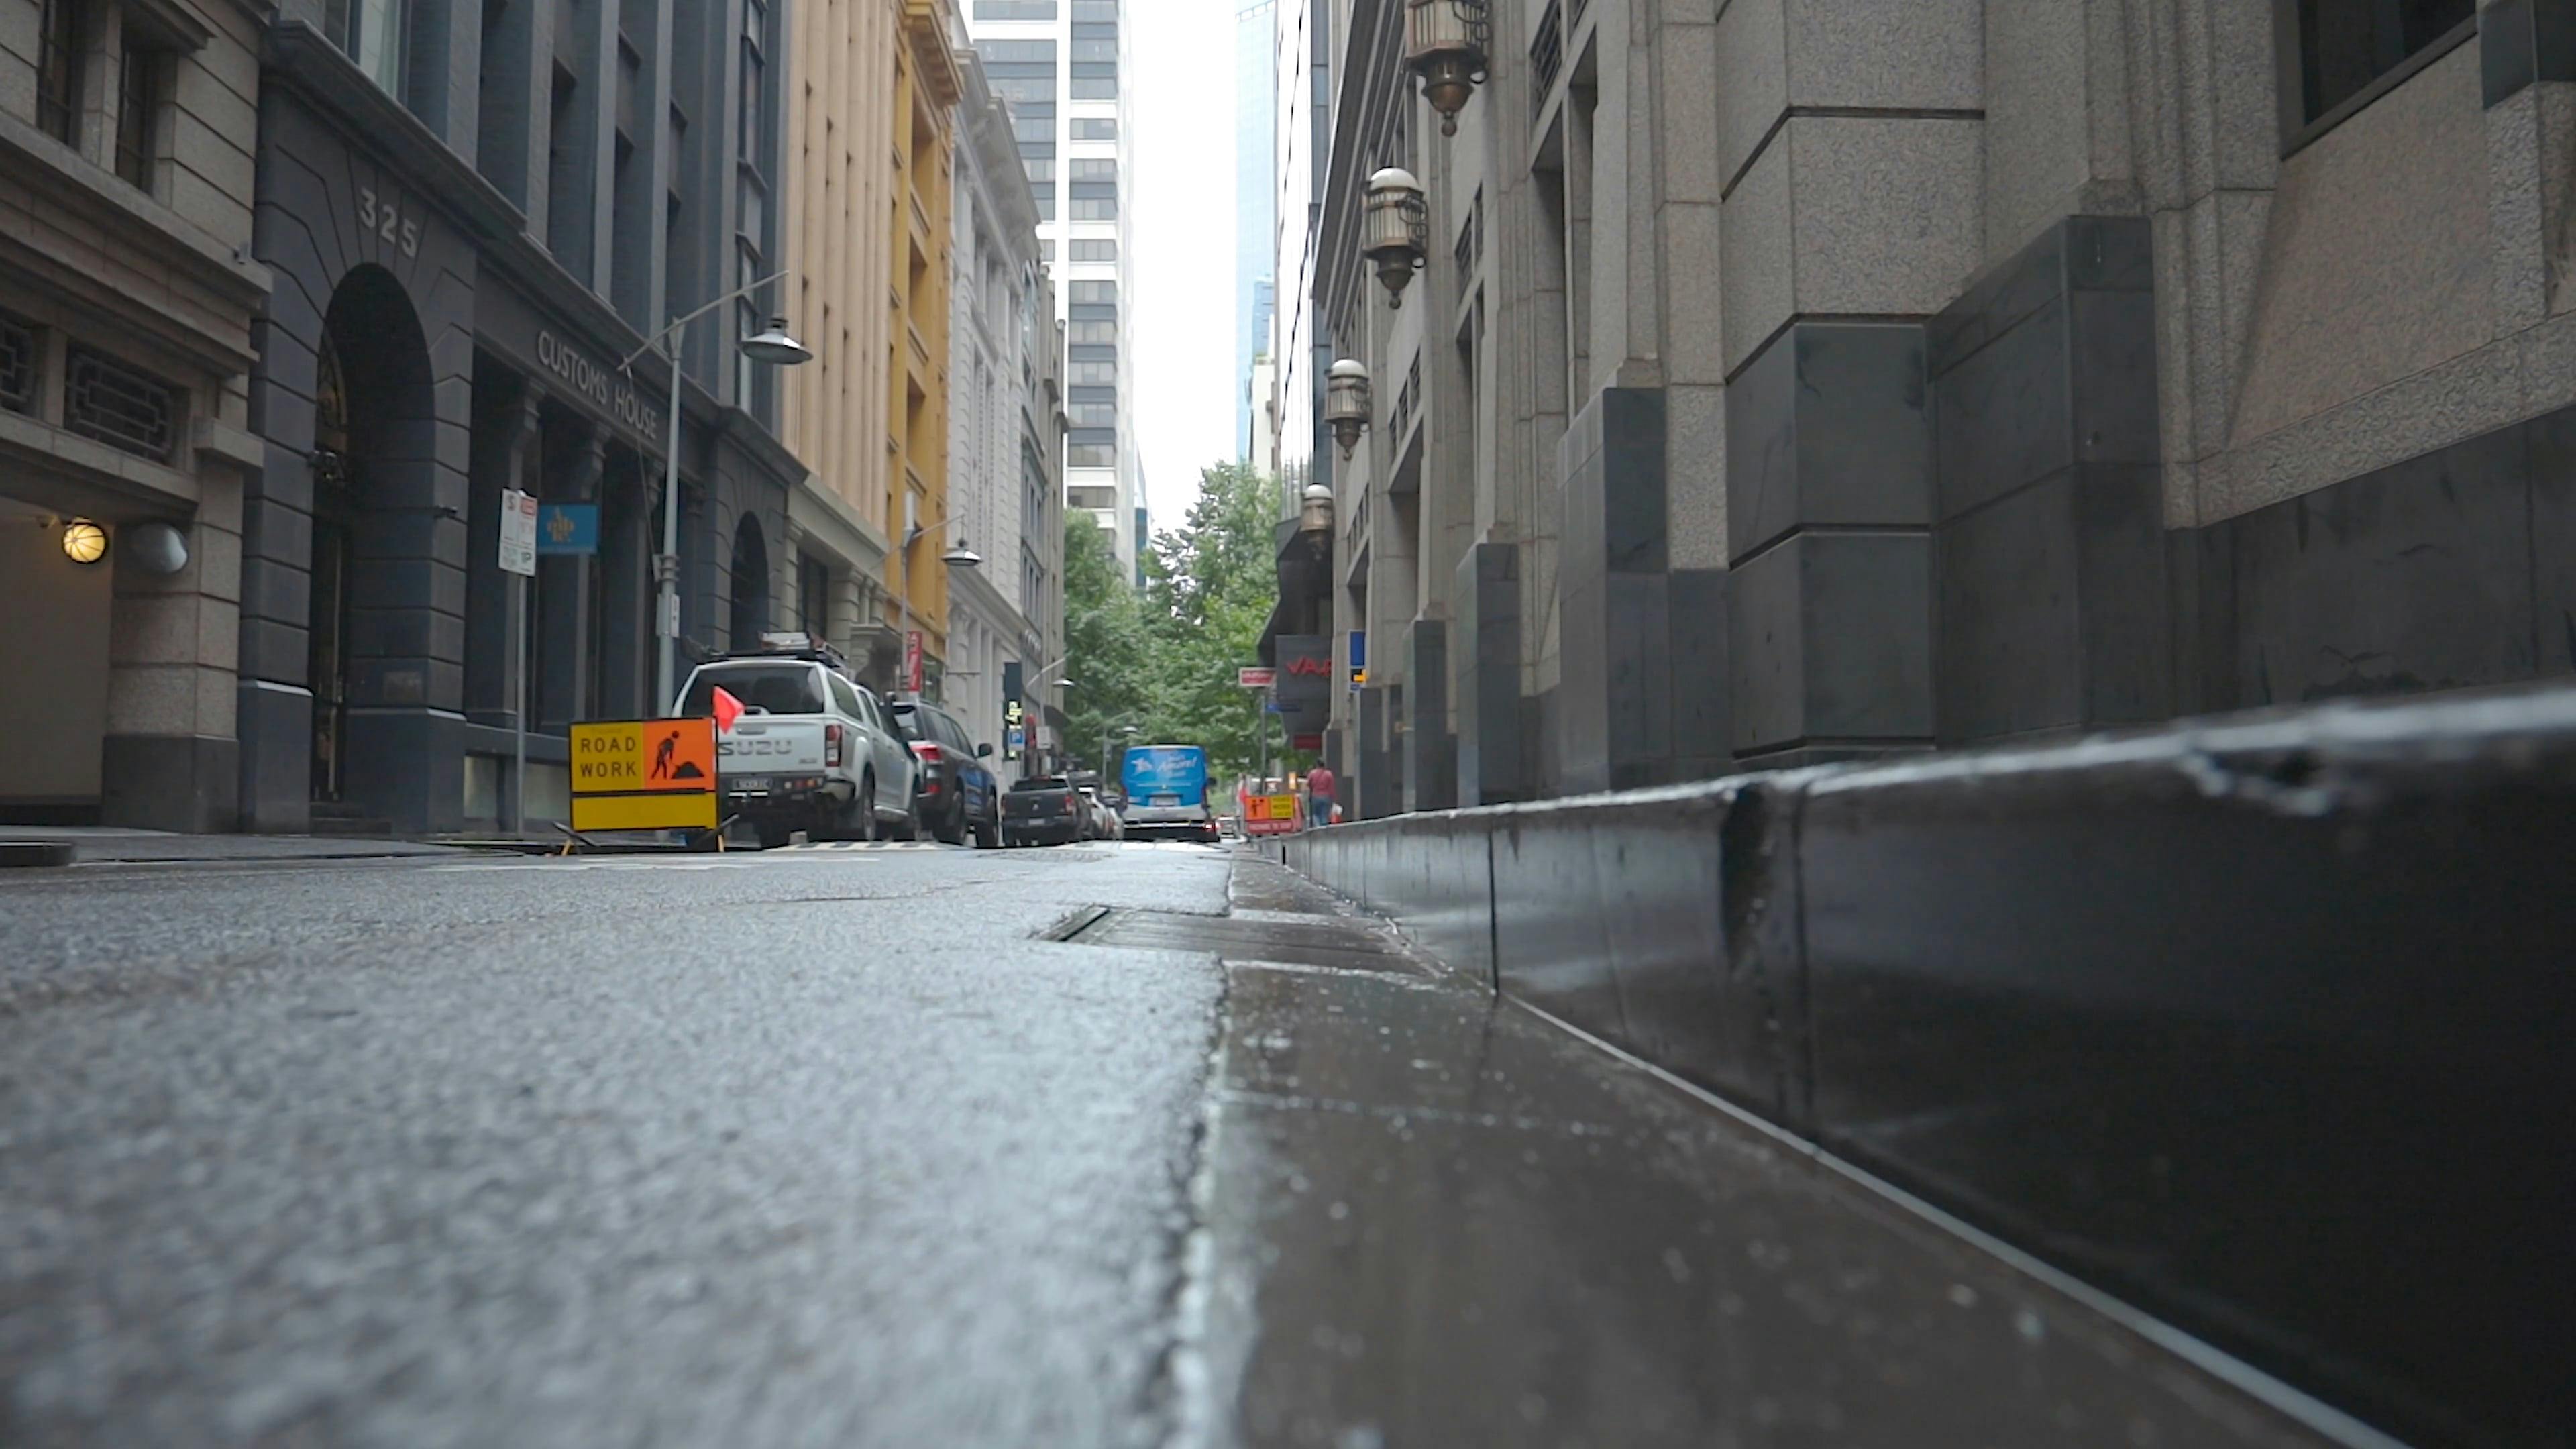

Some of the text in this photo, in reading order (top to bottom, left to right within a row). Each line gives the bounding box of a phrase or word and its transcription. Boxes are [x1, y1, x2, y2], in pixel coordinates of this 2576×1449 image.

[360, 186, 417, 258] 325
[538, 330, 657, 439] CUSTOMS HOUSE
[580, 736, 636, 753] ROAD
[718, 740, 792, 756] SUZU
[580, 761, 637, 778] WORK
